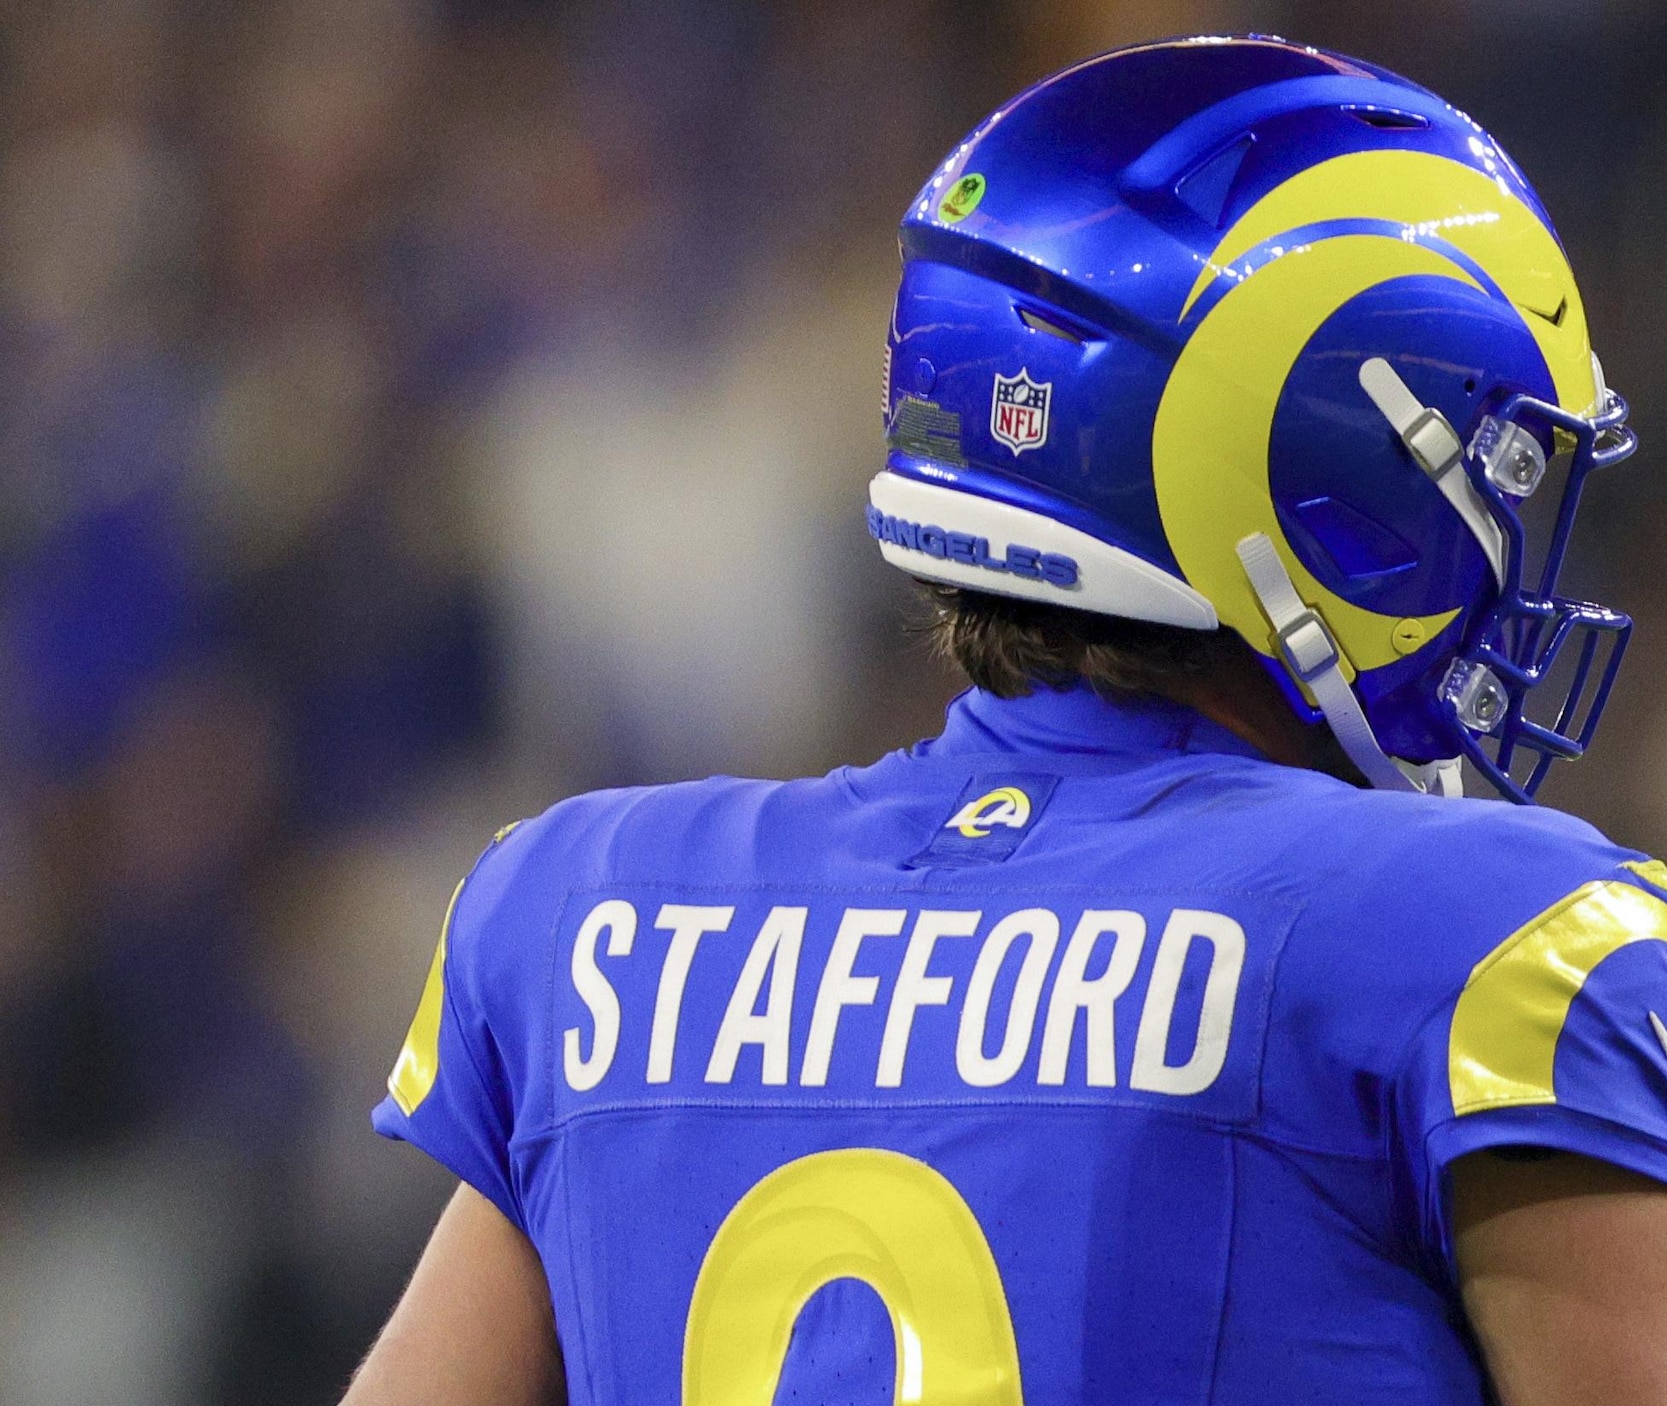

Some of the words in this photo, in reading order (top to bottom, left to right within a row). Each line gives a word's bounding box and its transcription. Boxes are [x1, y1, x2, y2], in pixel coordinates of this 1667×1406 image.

[998, 404, 1038, 441] NFL
[881, 514, 1079, 587] ANGELES
[563, 899, 1247, 1096] STAFFORD
